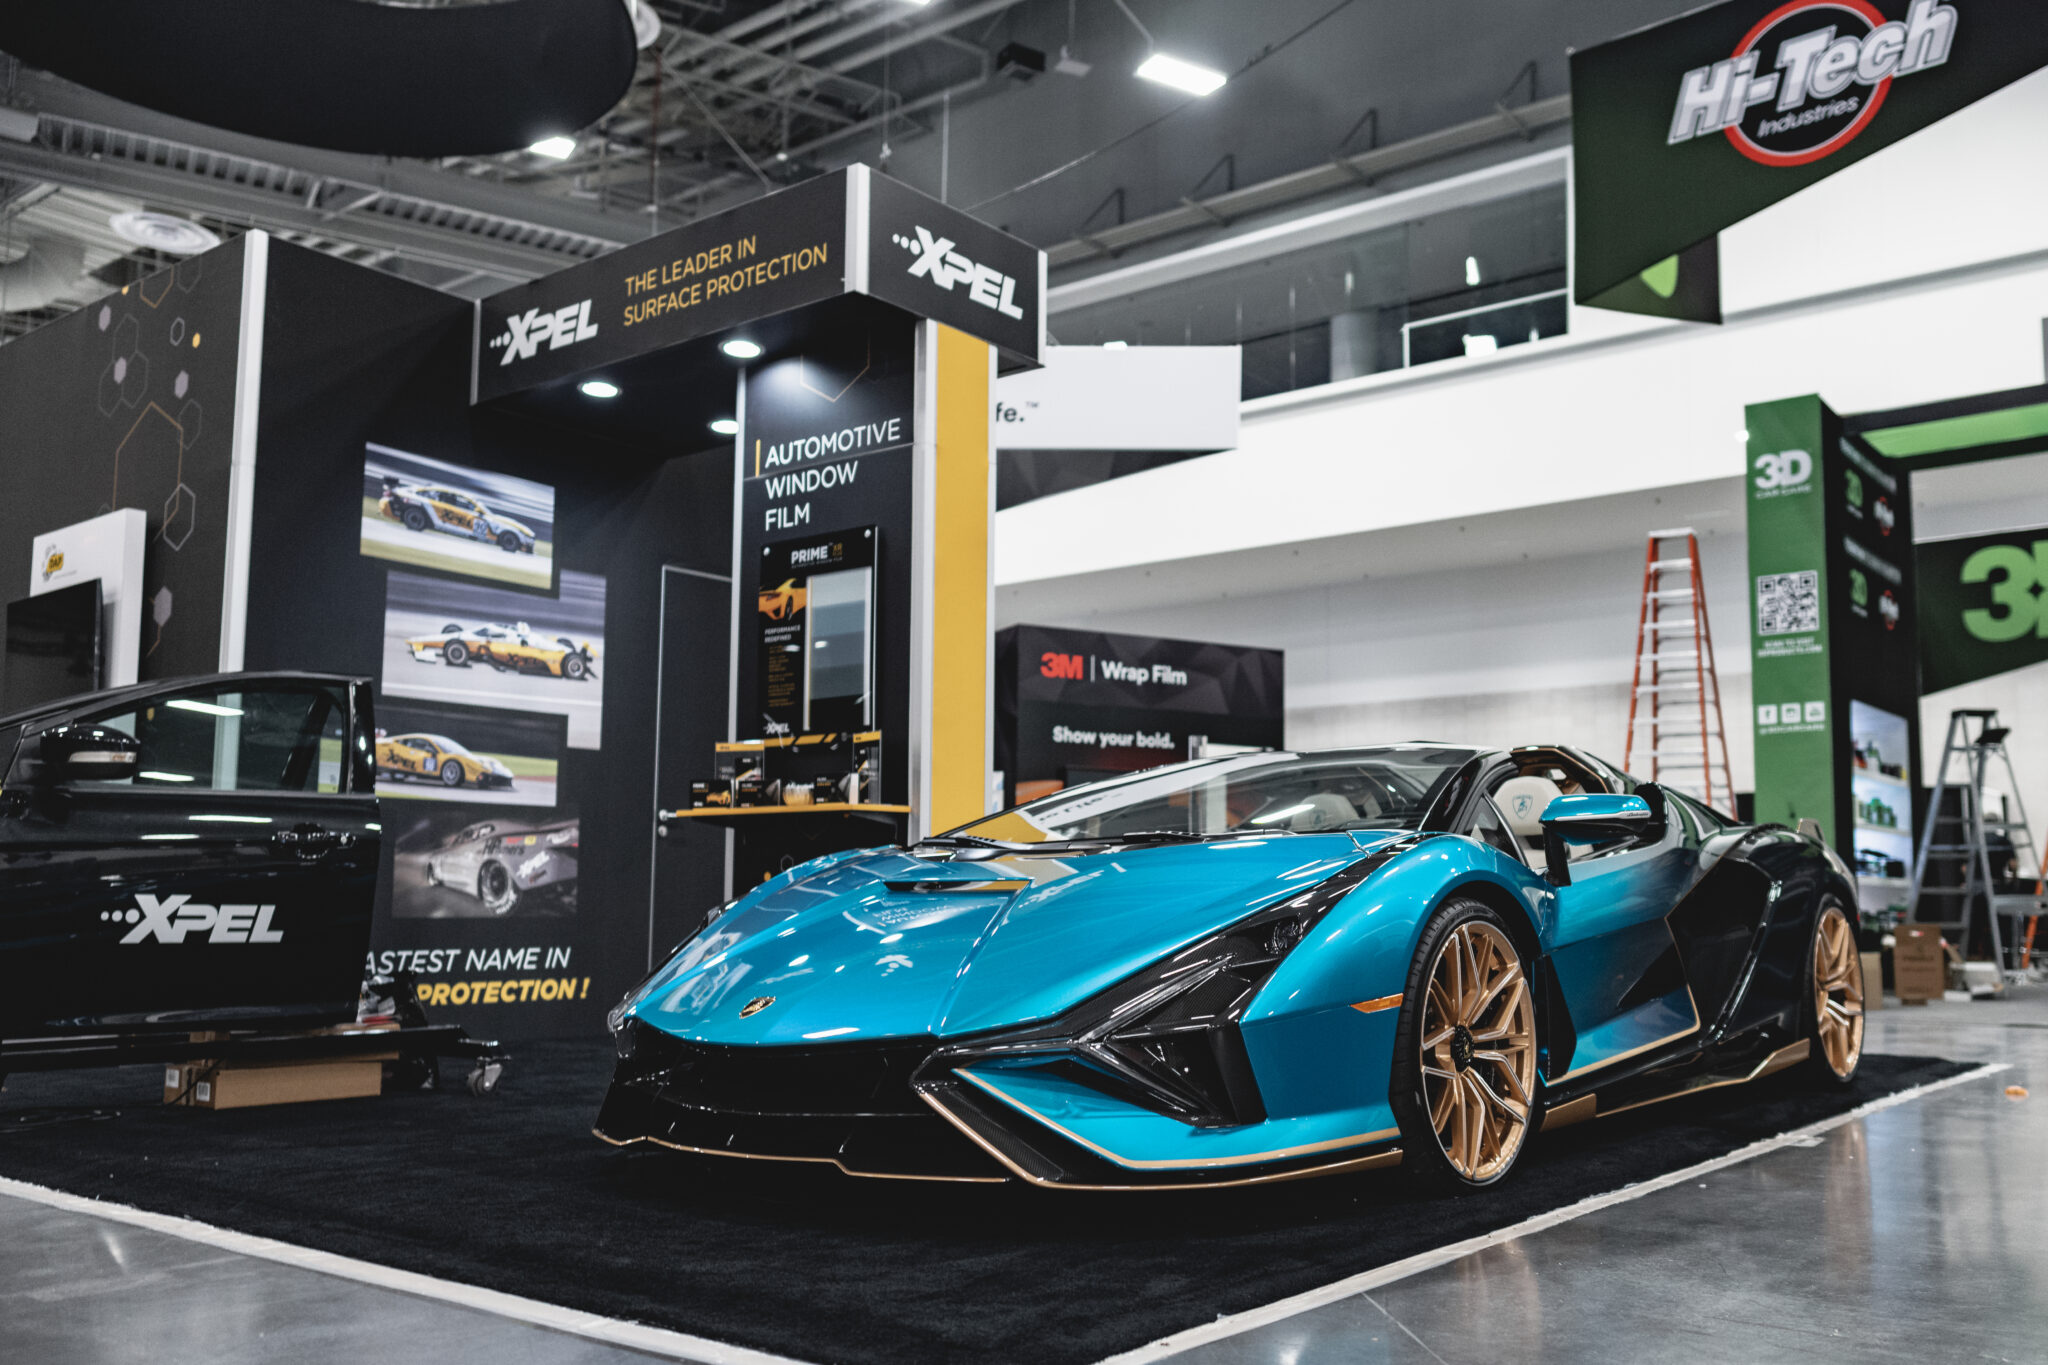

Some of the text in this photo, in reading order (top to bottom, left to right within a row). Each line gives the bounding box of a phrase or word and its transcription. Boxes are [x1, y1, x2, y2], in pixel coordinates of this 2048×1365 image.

[1667, 0, 1959, 145] Hi-Tech
[1757, 96, 1859, 138] Industries
[623, 241, 828, 327] SURFACE PROTECTION
[624, 234, 757, 297] THE LEADER IN
[907, 225, 1024, 320] XPEL
[499, 298, 599, 367] XPEL
[764, 417, 901, 469] AUTOMOTIVE
[764, 459, 859, 500] WINDOW
[1754, 448, 1813, 489] 3D
[765, 501, 811, 532] FILM
[790, 545, 829, 565] PRIME
[1960, 539, 2048, 643] 3
[1040, 652, 1188, 686] 3M Wrap Film
[1052, 725, 1176, 749] Show your bold.
[119, 893, 285, 944] XPEL
[366, 945, 572, 975] ASTEST NAME IN
[416, 977, 578, 1006] PROTECTION
